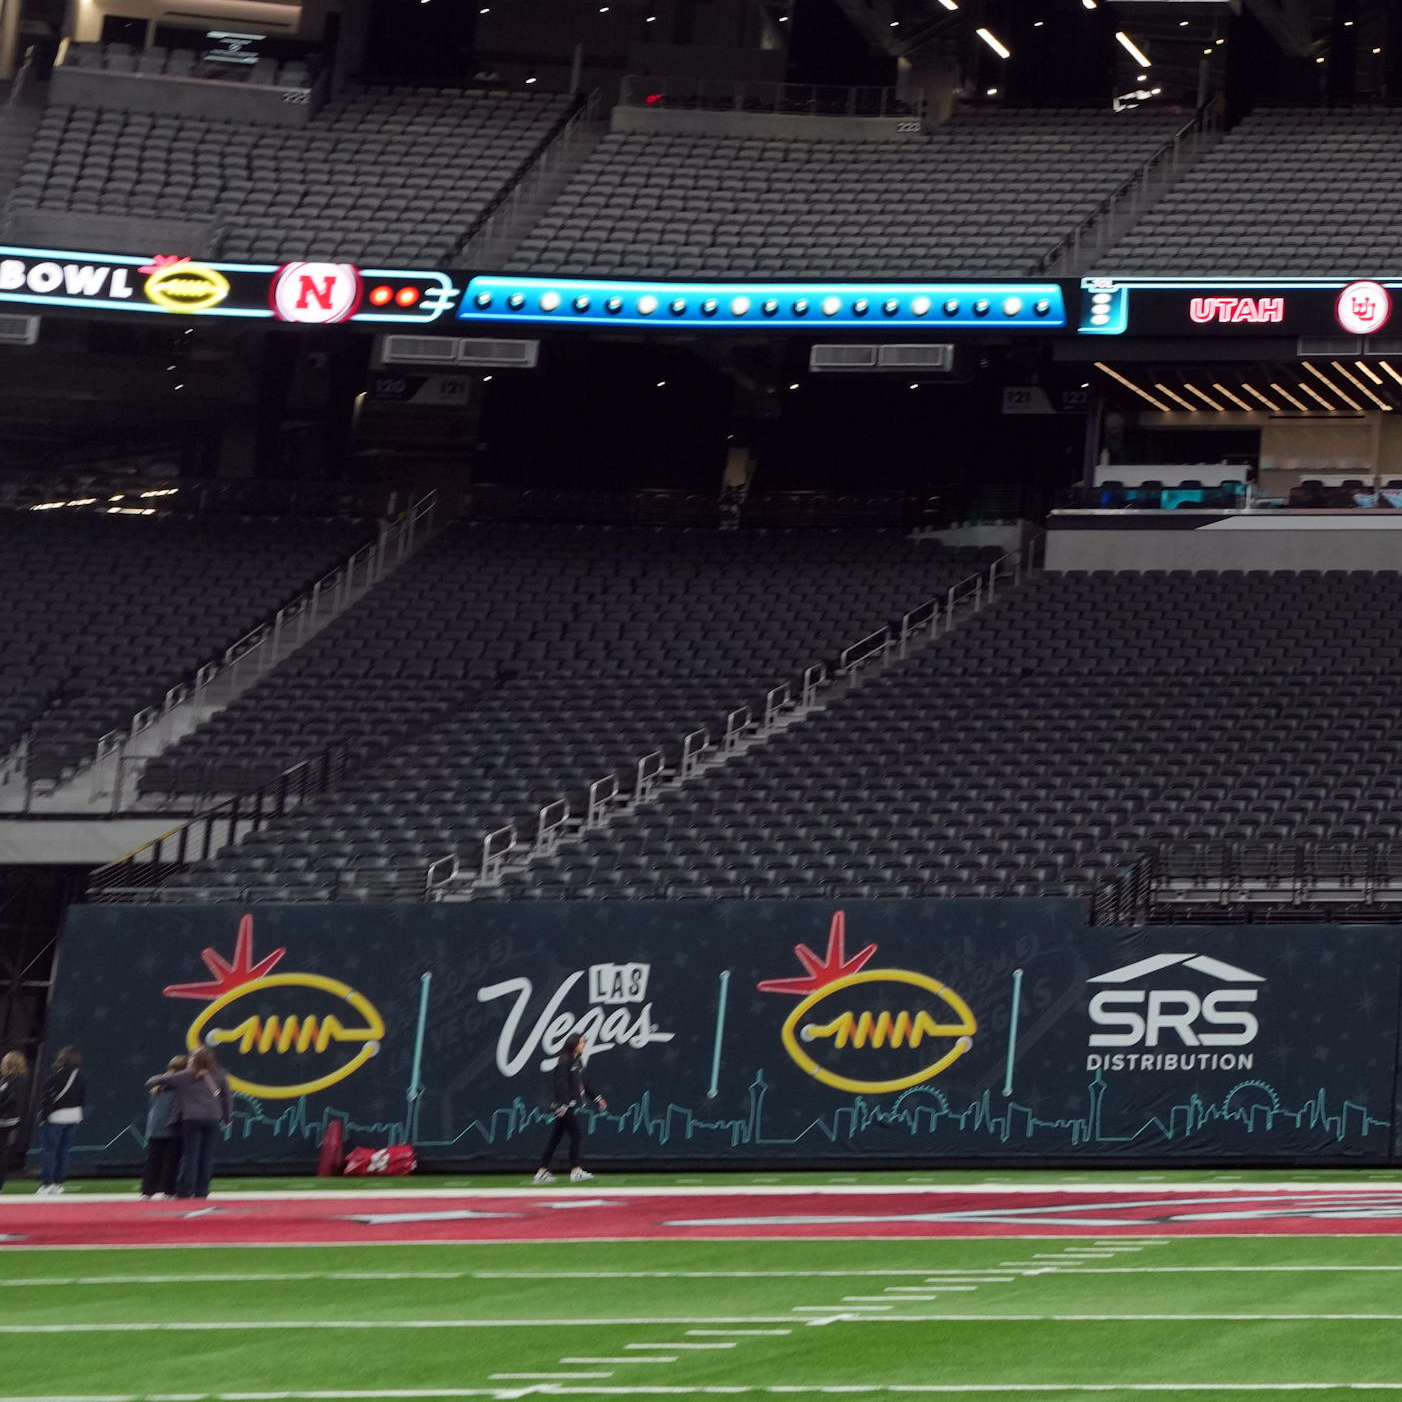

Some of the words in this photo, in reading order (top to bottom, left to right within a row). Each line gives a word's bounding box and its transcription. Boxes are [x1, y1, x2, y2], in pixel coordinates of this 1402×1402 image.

[0, 260, 133, 298] BOWL
[295, 275, 336, 309] N
[1189, 297, 1285, 324] UTAH
[1008, 391, 1031, 404] 121
[597, 967, 643, 1000] LAS
[477, 970, 675, 1076] Vegas
[1088, 989, 1259, 1046] SRS
[1086, 1053, 1255, 1072] DISTRIBUTION
